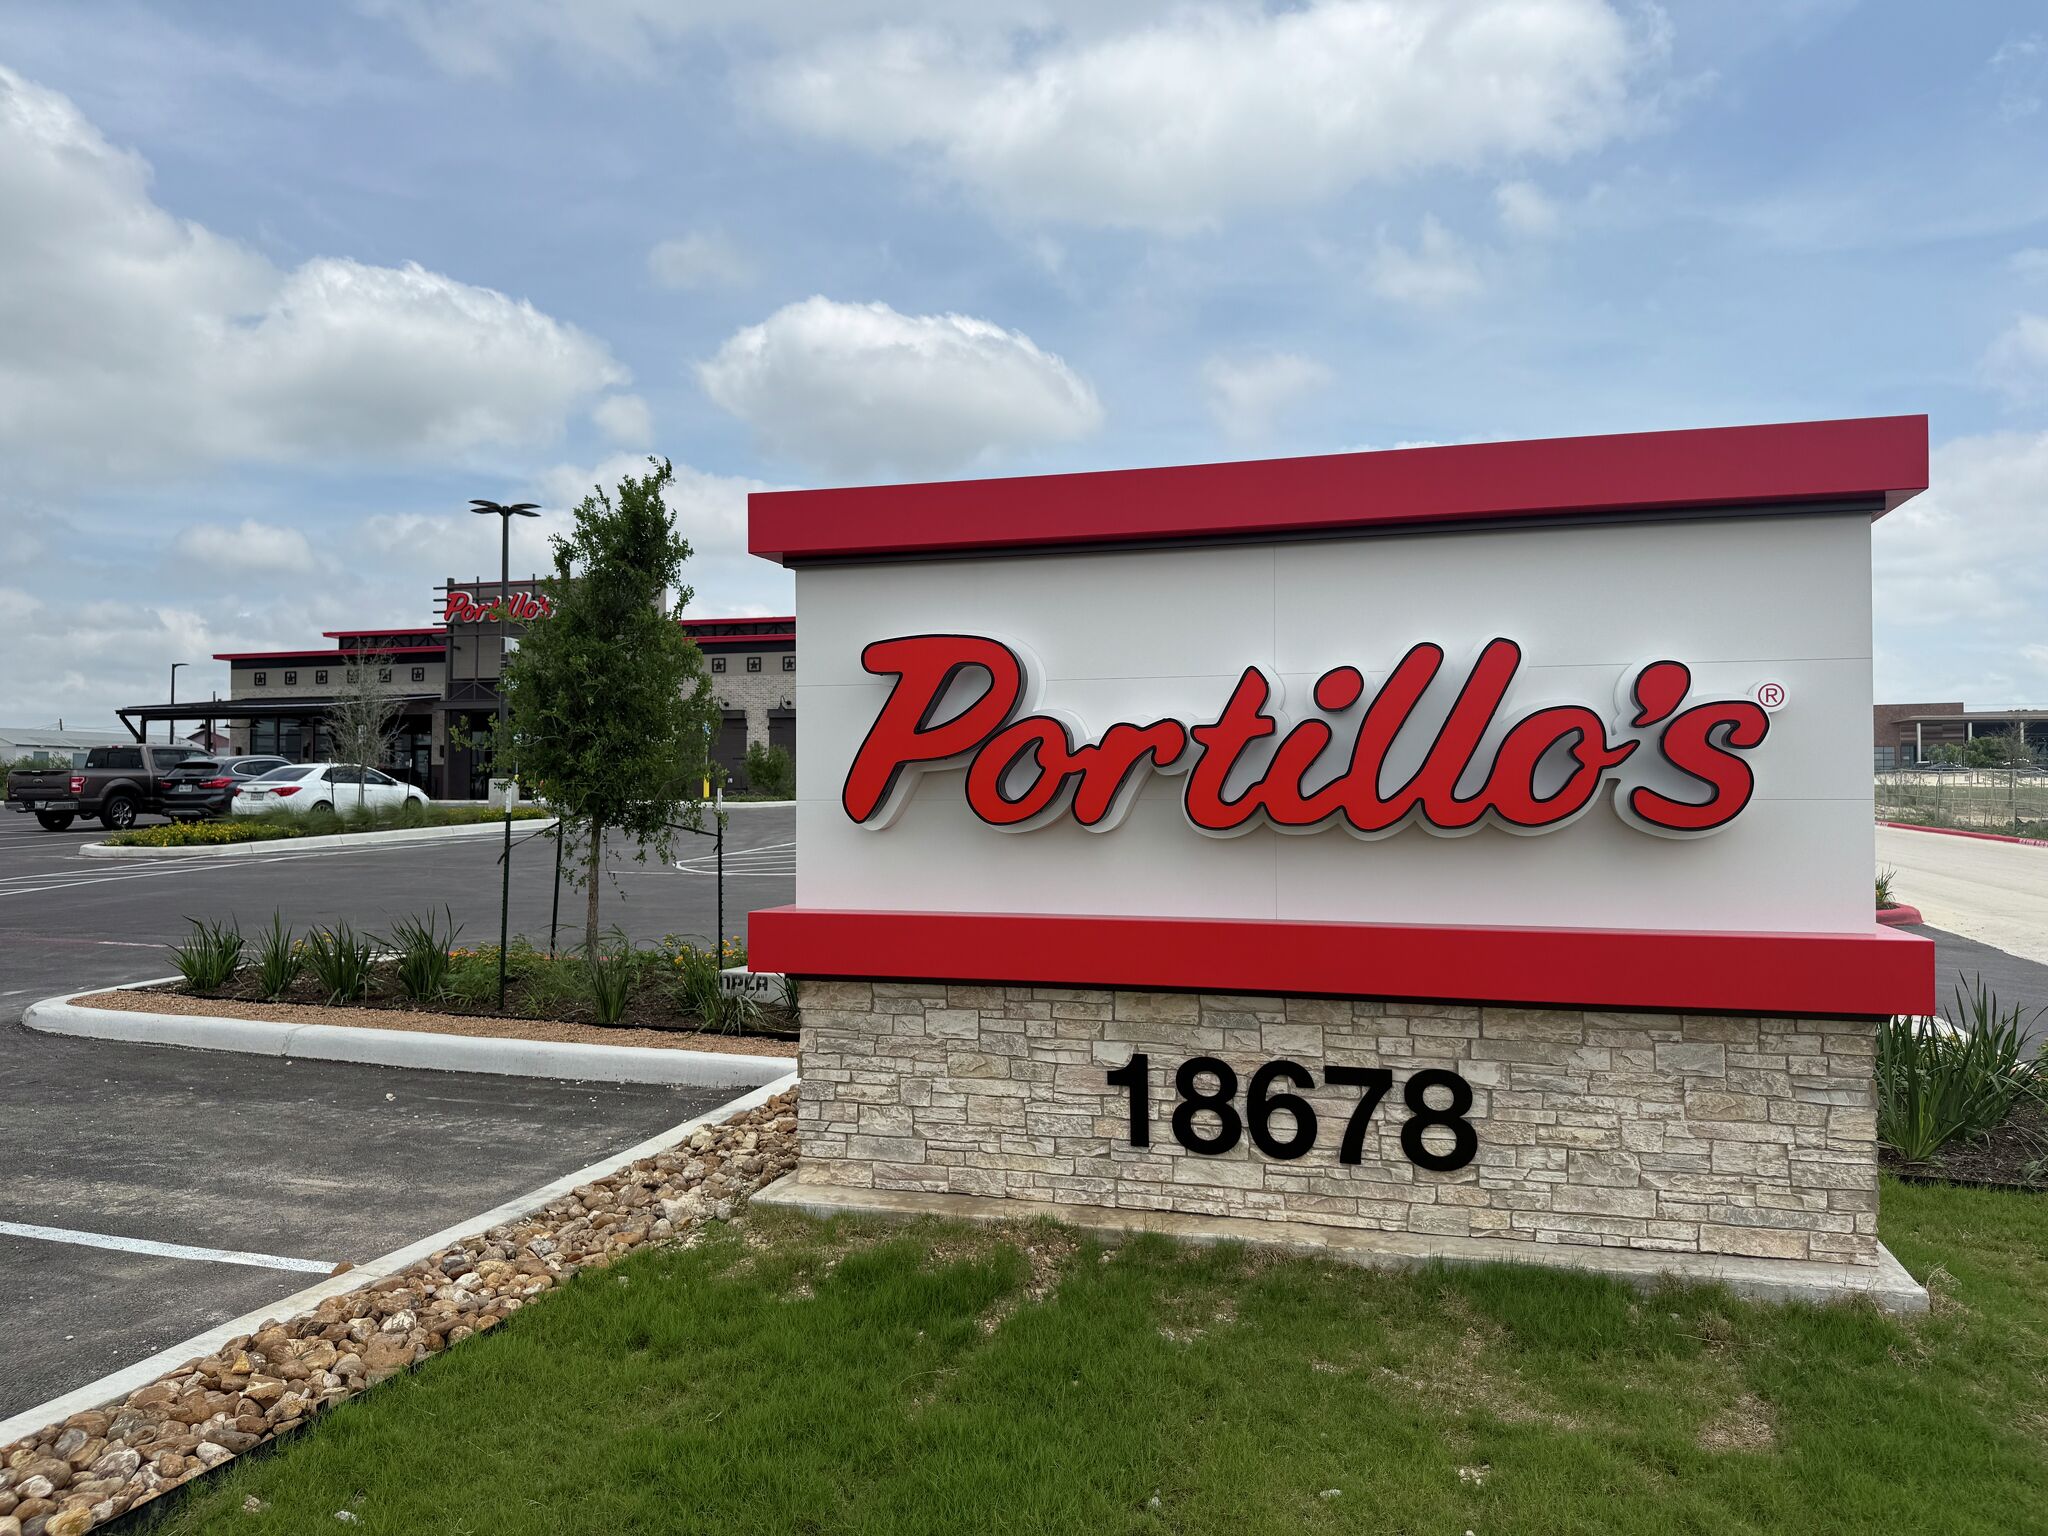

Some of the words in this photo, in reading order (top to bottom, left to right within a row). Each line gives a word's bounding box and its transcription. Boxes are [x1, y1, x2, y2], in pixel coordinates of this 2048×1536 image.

[443, 591, 556, 622] Portllo's
[841, 634, 1772, 832] Portillo's
[1106, 1053, 1478, 1173] 18678
